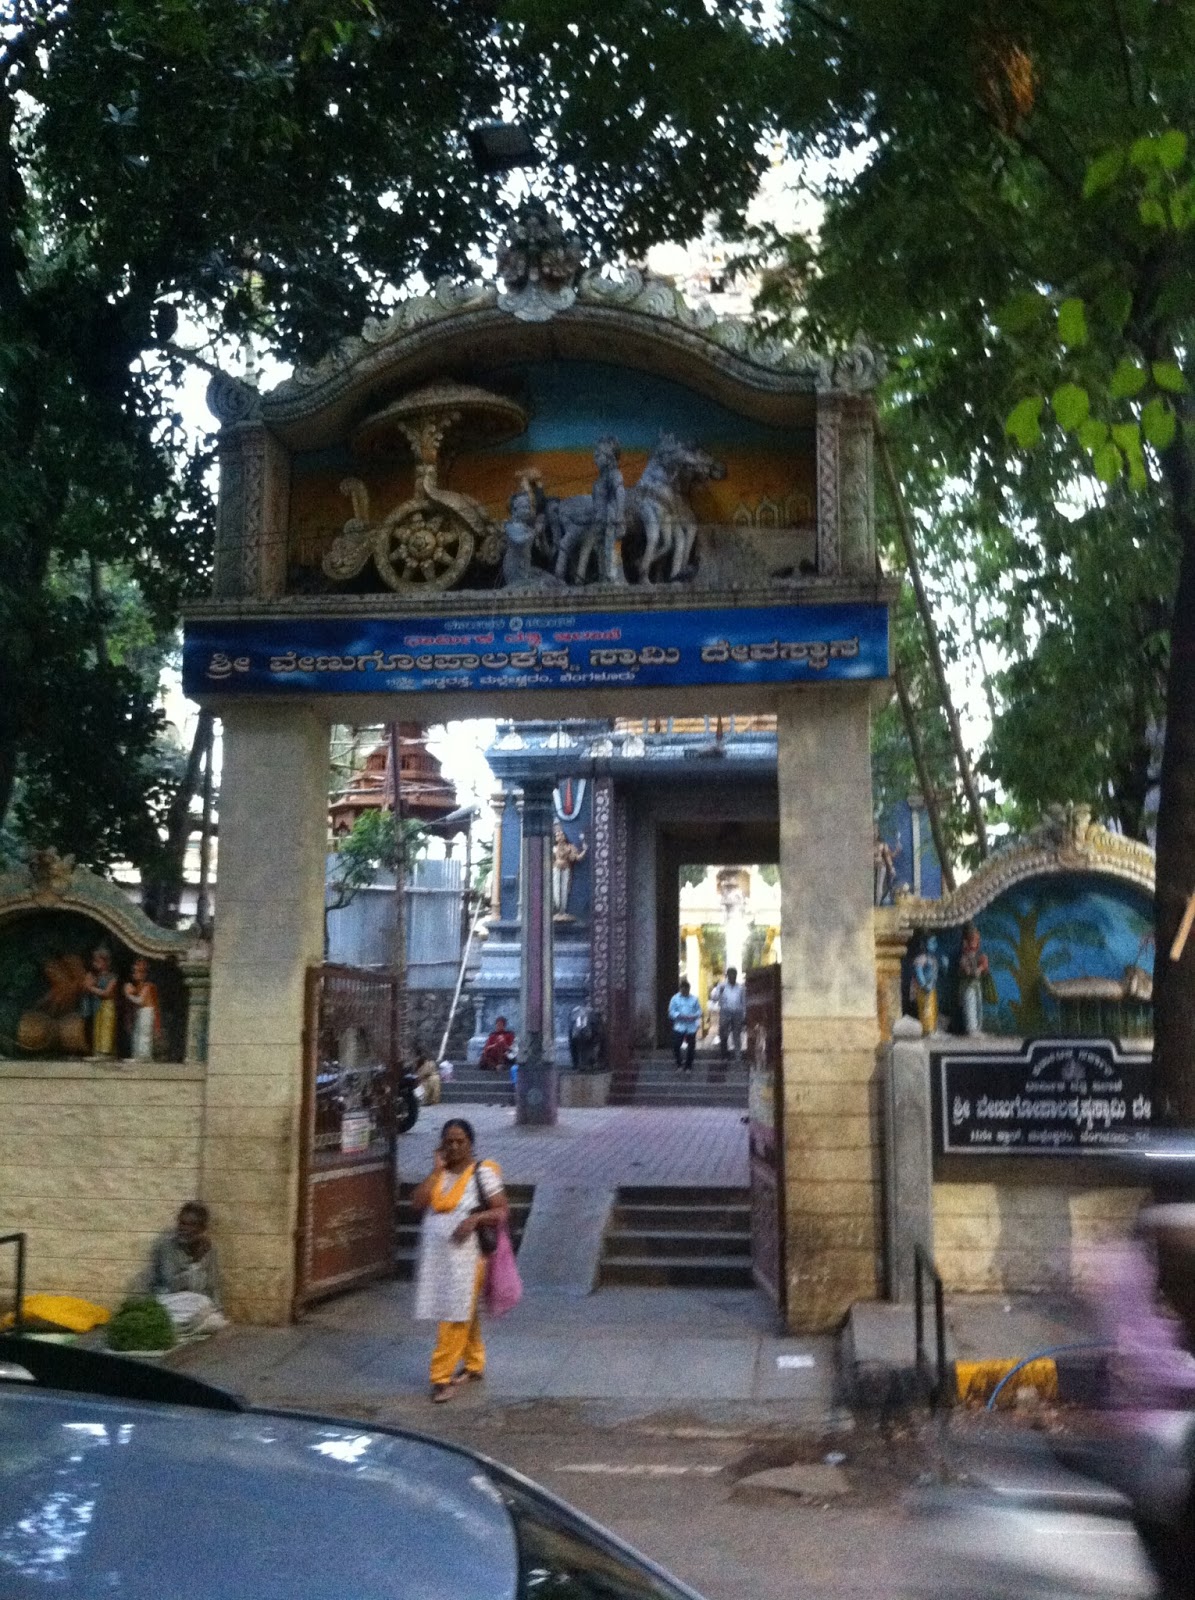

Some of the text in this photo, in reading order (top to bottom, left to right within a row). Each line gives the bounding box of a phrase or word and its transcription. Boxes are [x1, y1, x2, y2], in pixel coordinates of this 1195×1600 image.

[207, 652, 250, 680] ಶ್ರೀ
[589, 645, 681, 672] ಸ್ವಾಮಿ
[701, 635, 860, 671] ದೇವಸ್ಥಾನ
